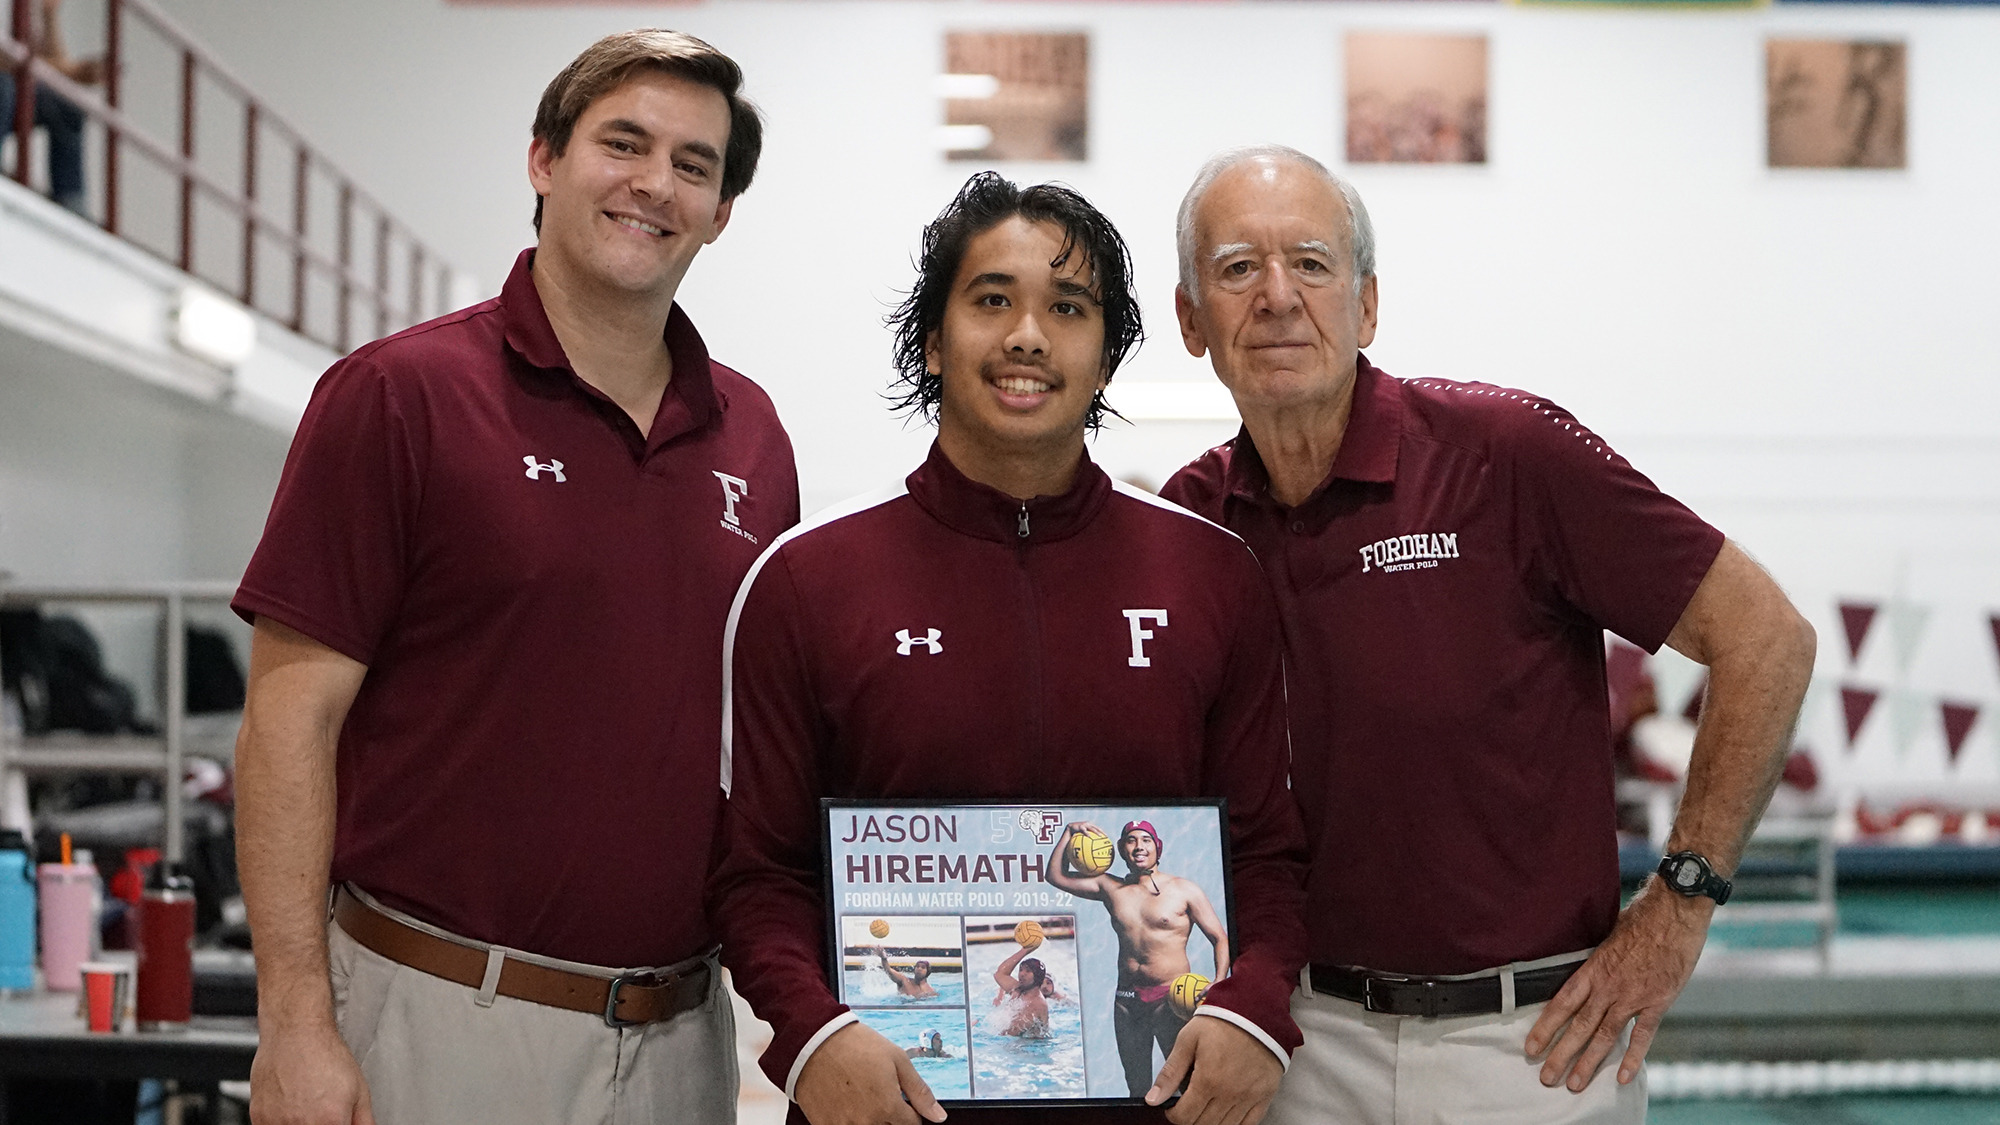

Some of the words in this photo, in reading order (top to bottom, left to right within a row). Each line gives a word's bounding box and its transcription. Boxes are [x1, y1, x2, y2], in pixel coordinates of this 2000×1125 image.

[712, 470, 748, 526] F
[1359, 533, 1459, 573] FORDHAM
[1383, 562, 1415, 573] WATER
[1416, 560, 1438, 569] POLO
[1122, 609, 1168, 667] F
[841, 815, 957, 842] JASON
[991, 810, 1013, 843] 5
[1038, 813, 1061, 843] F
[1074, 847, 1081, 859] F
[846, 854, 1045, 883] HIREMATH
[844, 892, 913, 907] FORDHAM
[918, 892, 963, 907] WATER
[968, 891, 1005, 907] POLO
[1013, 891, 1073, 907] 2019-22
[1176, 985, 1184, 994] F
